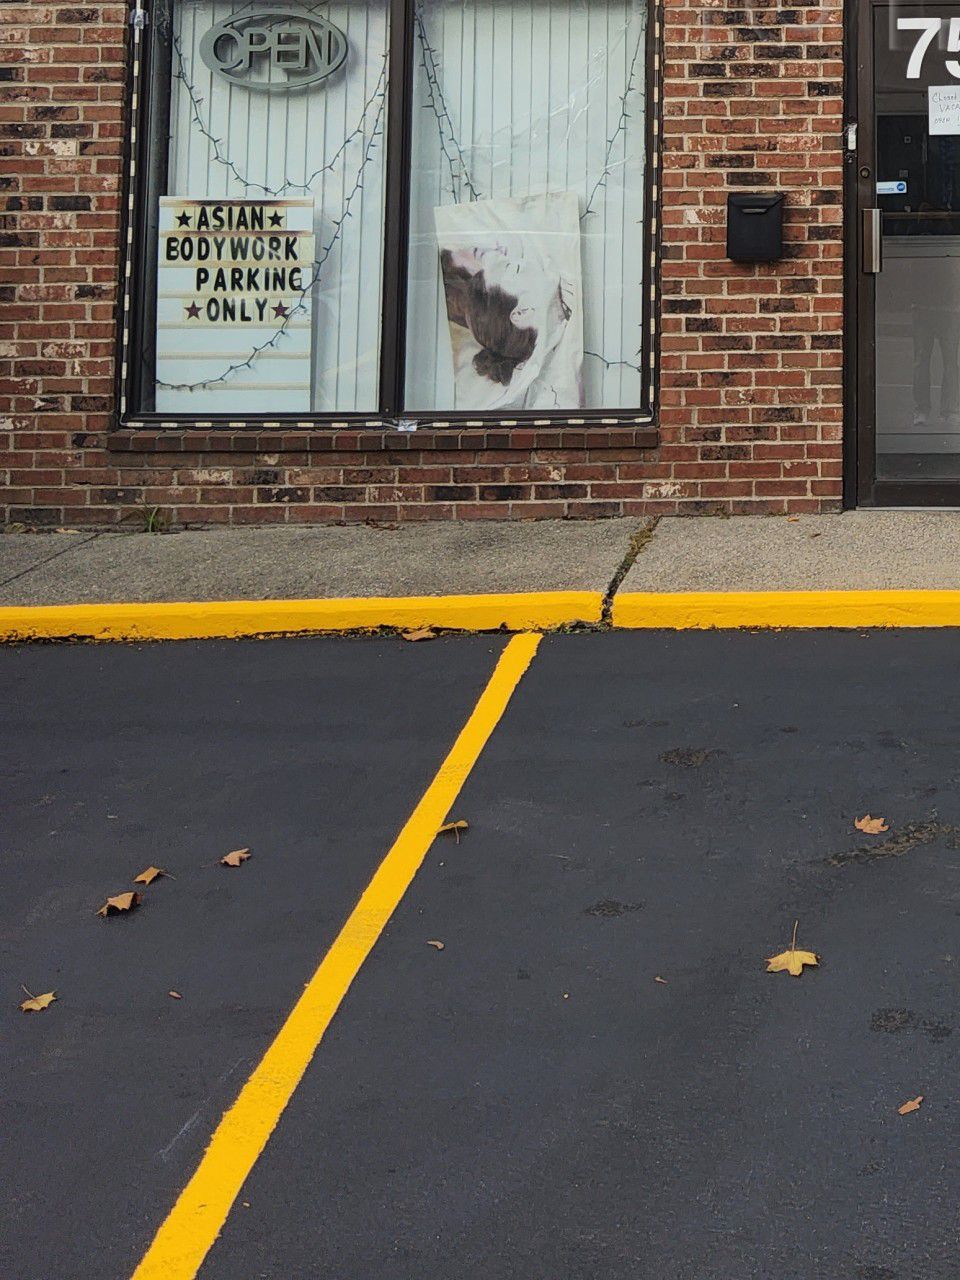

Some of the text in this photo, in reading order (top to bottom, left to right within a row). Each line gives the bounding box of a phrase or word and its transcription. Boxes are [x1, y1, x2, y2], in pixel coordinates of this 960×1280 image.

[206, 25, 334, 71] OPEN
[197, 206, 264, 231] ASIAN
[166, 236, 298, 261] BODYWORK
[196, 267, 302, 291] PARKING
[206, 297, 268, 322] ONLY
